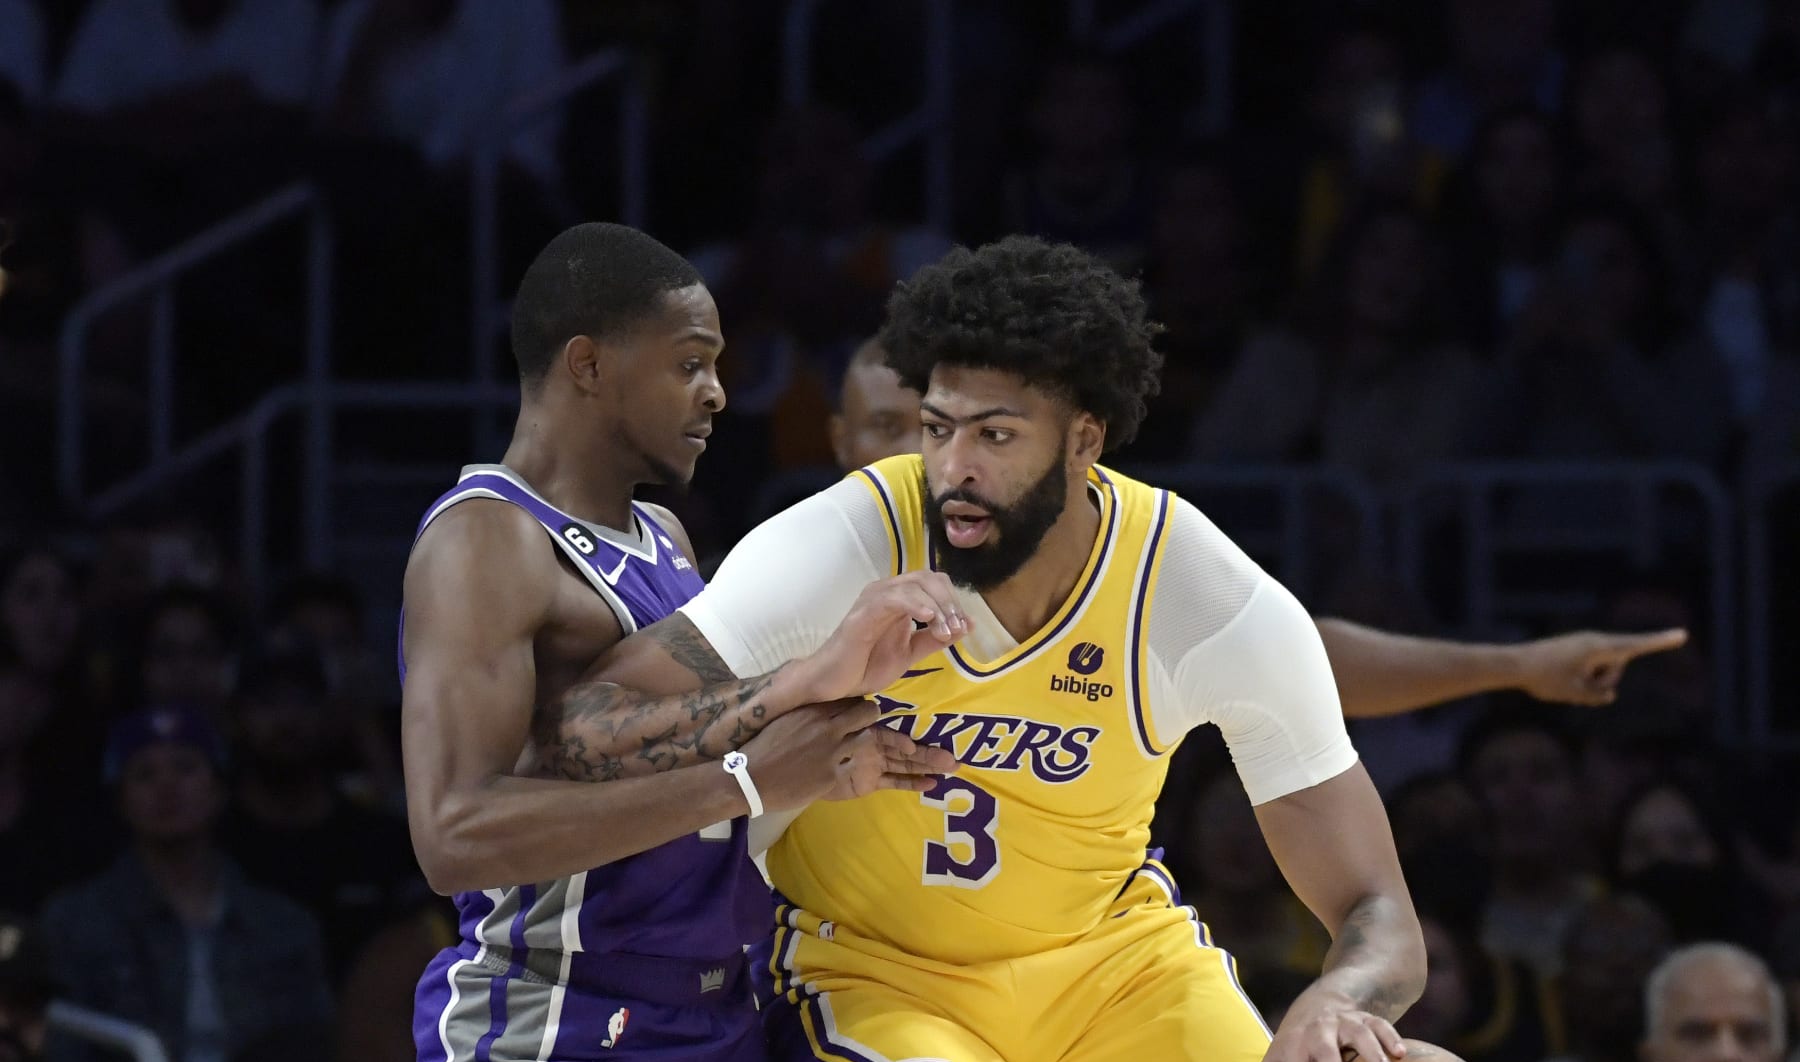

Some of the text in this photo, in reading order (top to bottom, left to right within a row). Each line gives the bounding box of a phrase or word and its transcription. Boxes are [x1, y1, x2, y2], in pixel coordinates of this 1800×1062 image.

[564, 527, 595, 554] 6
[1050, 674, 1114, 702] bibigo
[868, 694, 1103, 784] AKERS
[920, 774, 1001, 890] 3
